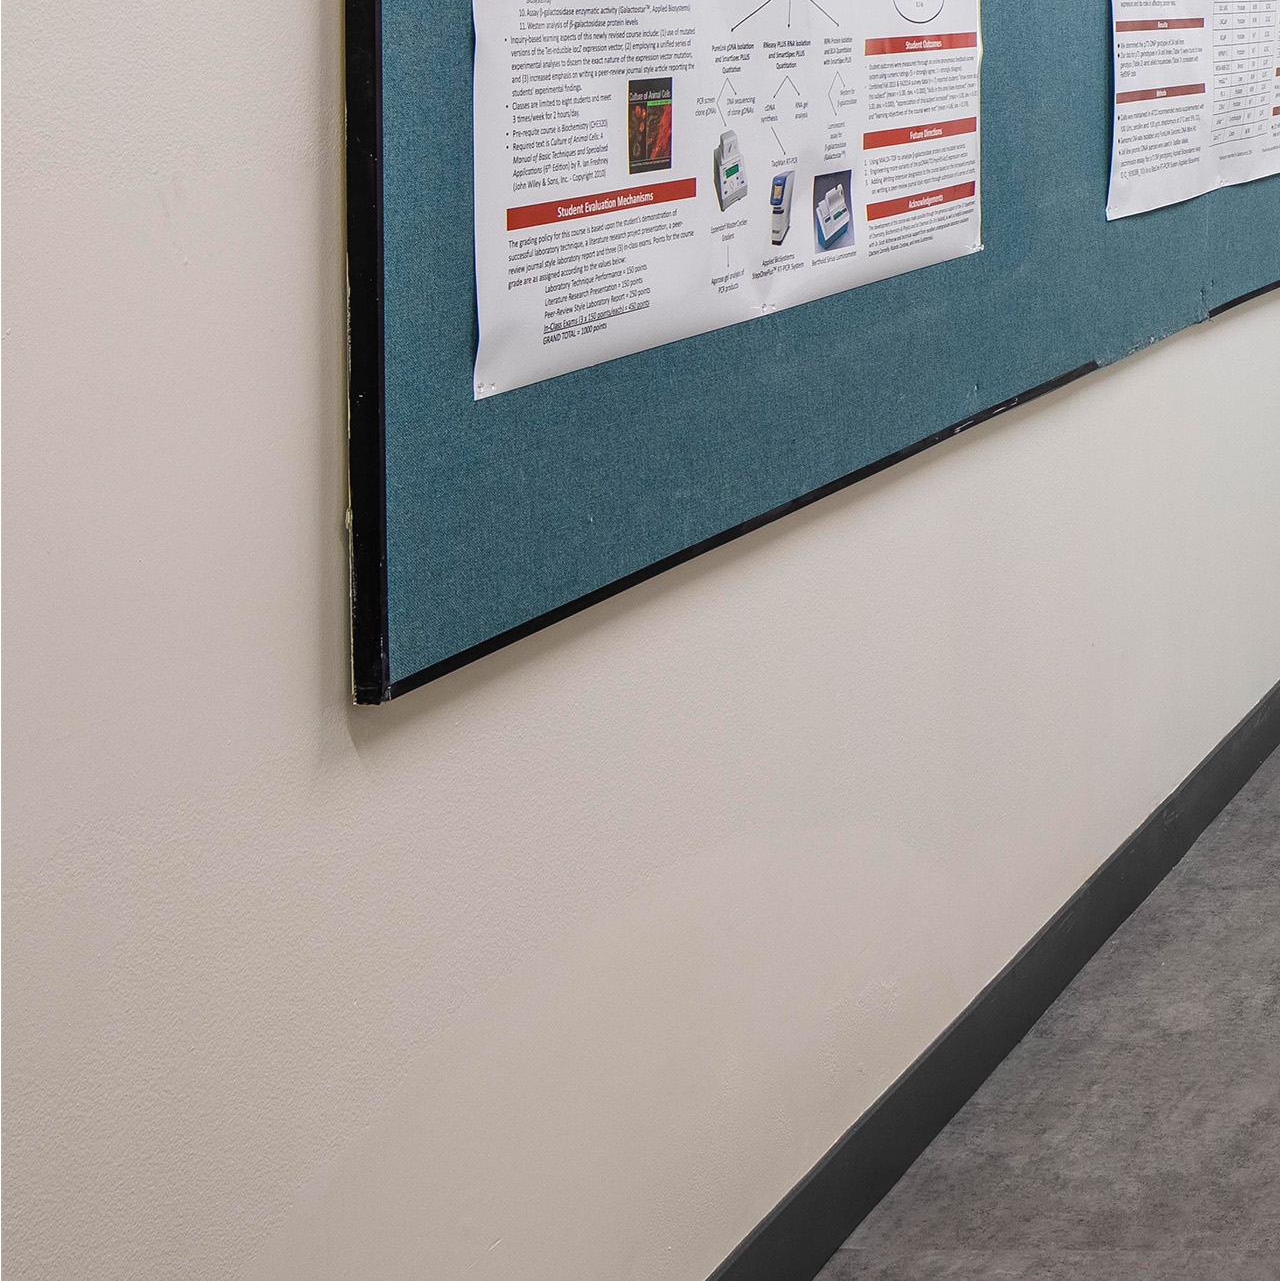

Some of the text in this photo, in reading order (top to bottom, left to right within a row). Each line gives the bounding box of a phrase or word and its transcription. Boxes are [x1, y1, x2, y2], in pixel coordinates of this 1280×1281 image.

[905, 40, 942, 50] Student Outcomes
[630, 92, 643, 101] Culture
[649, 90, 661, 99] Animal
[662, 90, 670, 98] Cells
[910, 128, 942, 140] Future Directions
[557, 192, 654, 218] Student Evaluation Mechanisms
[545, 281, 570, 293] Laboratory
[571, 276, 594, 287] Technique
[595, 270, 622, 281] Performance
[626, 266, 634, 274] 150
[635, 264, 647, 274] points
[545, 296, 568, 306] Literature
[568, 290, 589, 300] Research
[590, 284, 617, 295] Presentation
[621, 280, 629, 288] 150
[630, 277, 643, 287] points
[544, 307, 573, 319] Peer-Review
[574, 303, 585, 312] Style
[586, 298, 610, 308] Laboratory
[611, 294, 625, 303] Report
[638, 287, 651, 298] points
[544, 322, 562, 332] In-Class
[563, 318, 578, 328] Exams
[637, 300, 650, 309] points
[543, 333, 561, 345] GRAND
[562, 330, 576, 340] TOTAL
[581, 326, 592, 335] 1000
[593, 323, 607, 333] points
